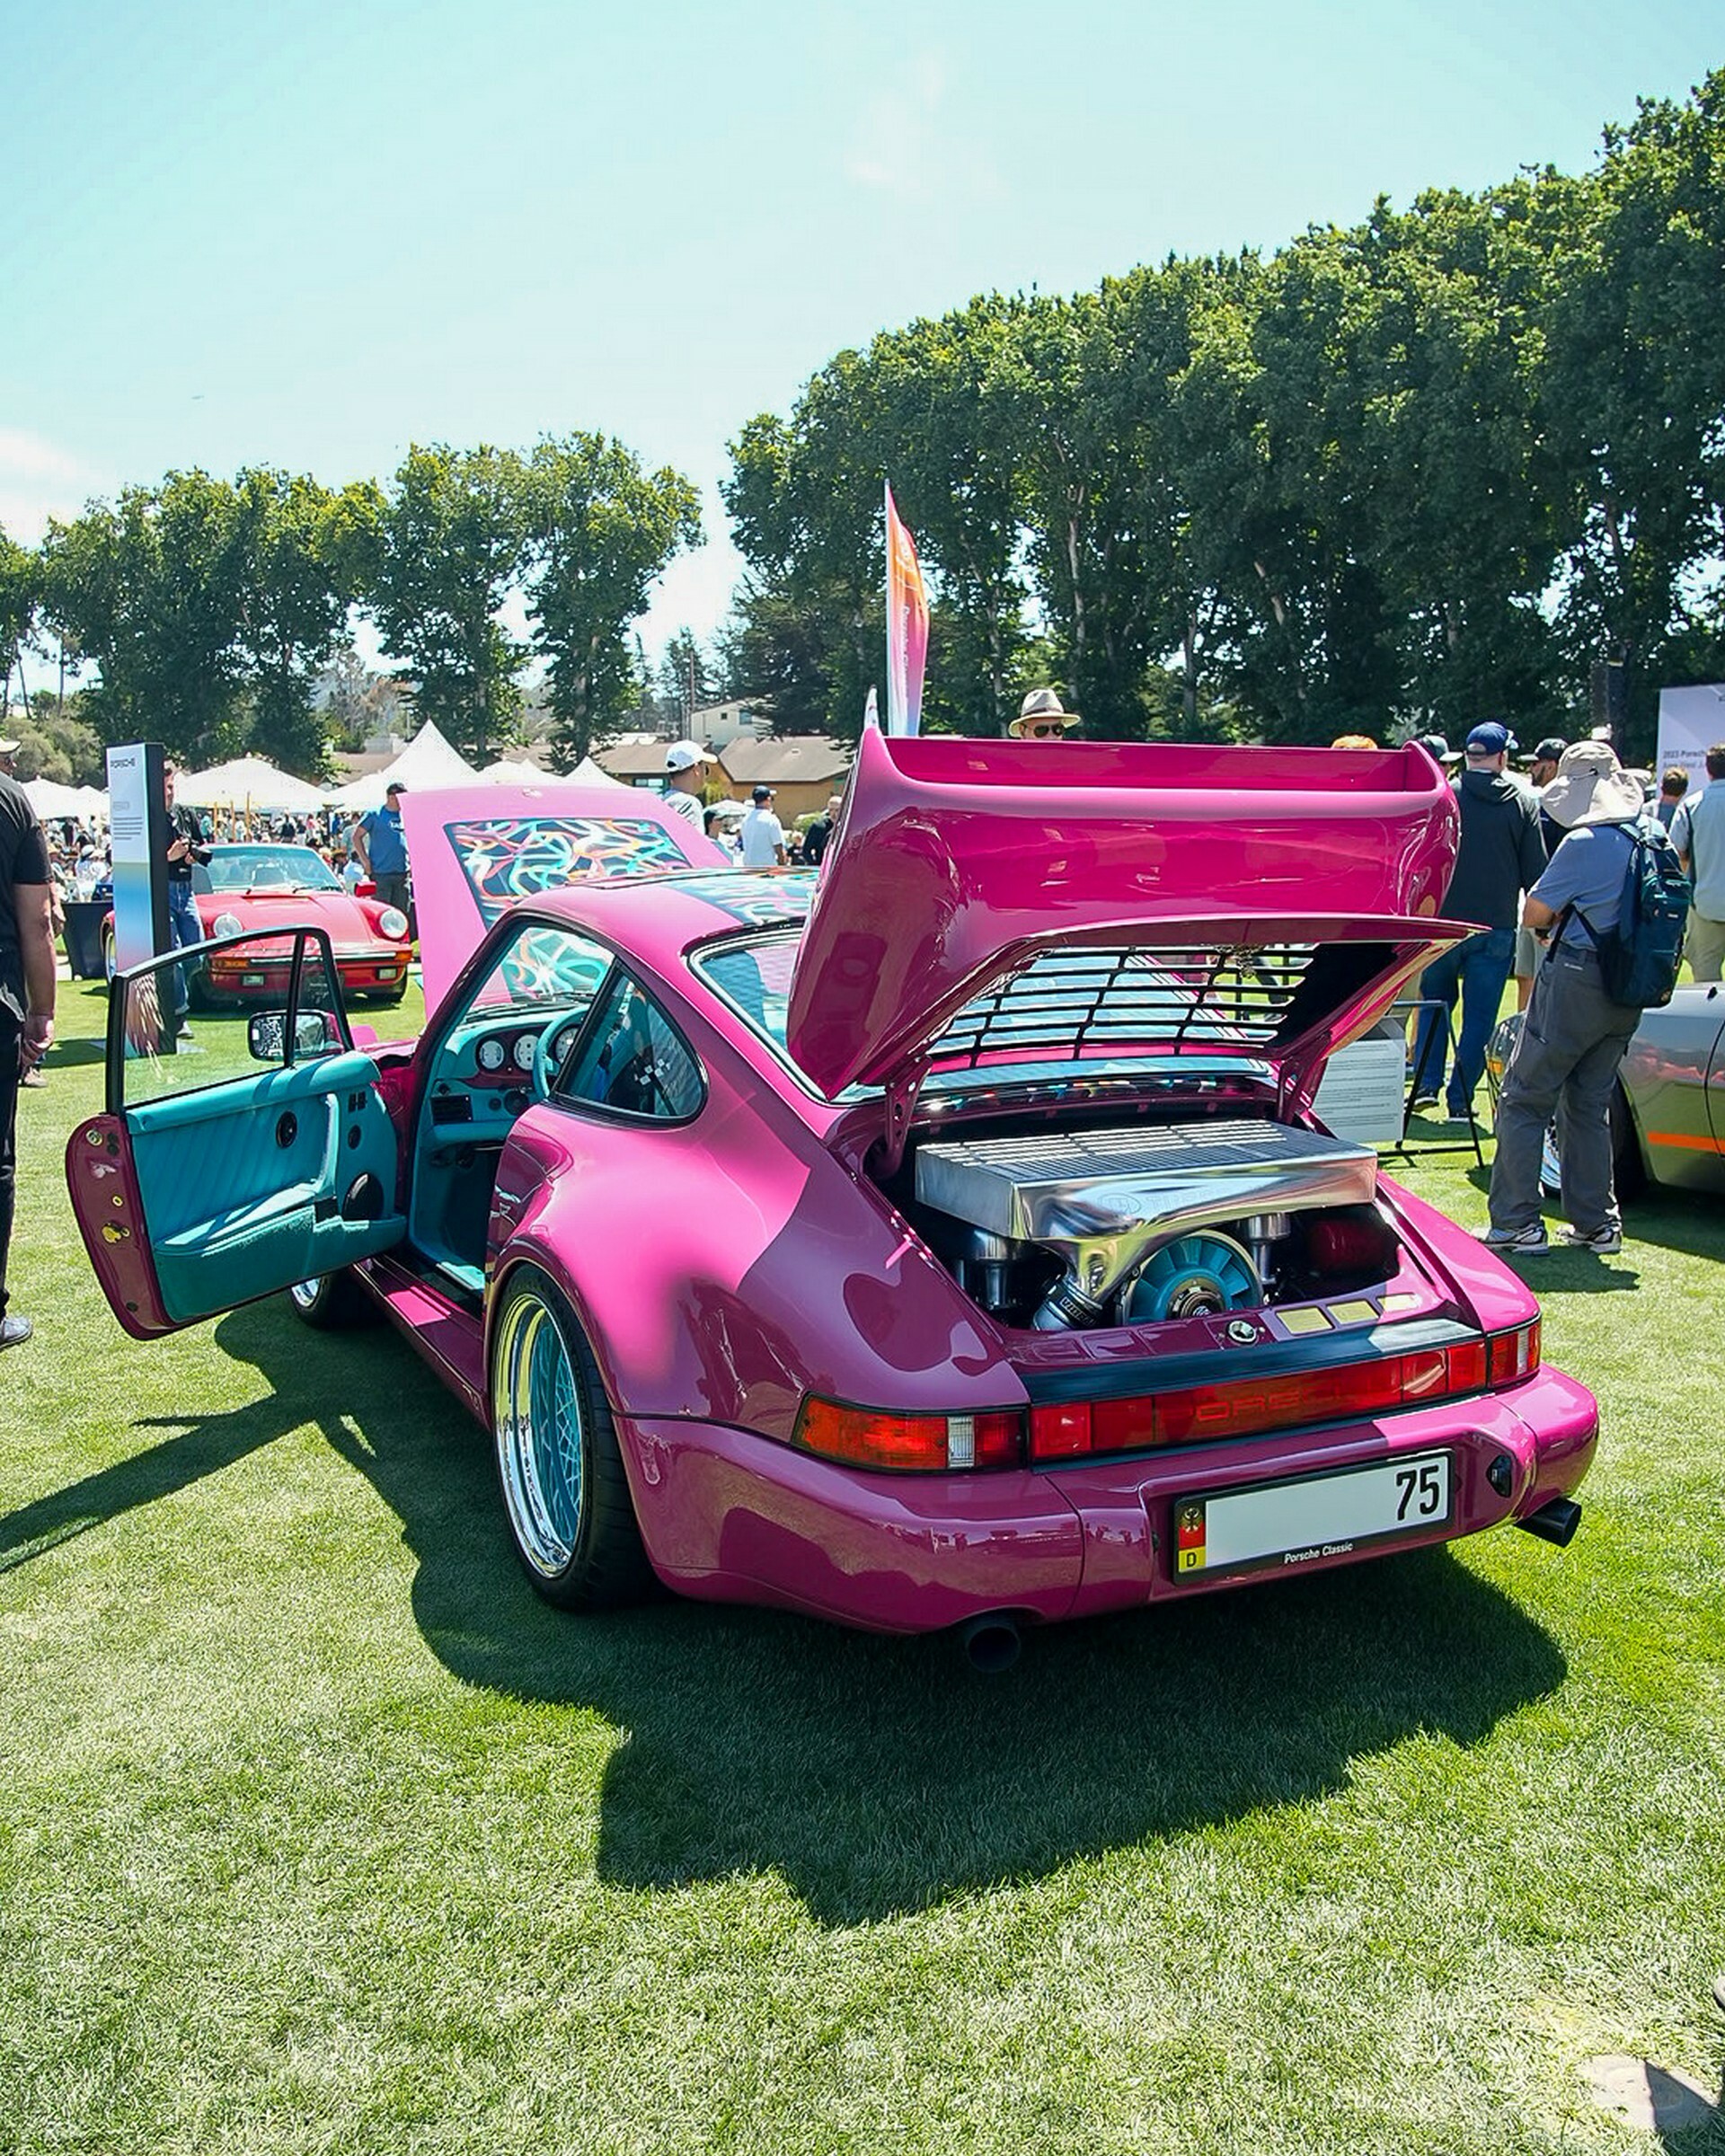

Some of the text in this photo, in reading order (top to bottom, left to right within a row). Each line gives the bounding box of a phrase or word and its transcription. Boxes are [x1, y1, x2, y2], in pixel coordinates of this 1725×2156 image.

[1396, 1465, 1440, 1521] 75
[1186, 1552, 1197, 1568] D
[1284, 1541, 1354, 1564] Porsche Classic
